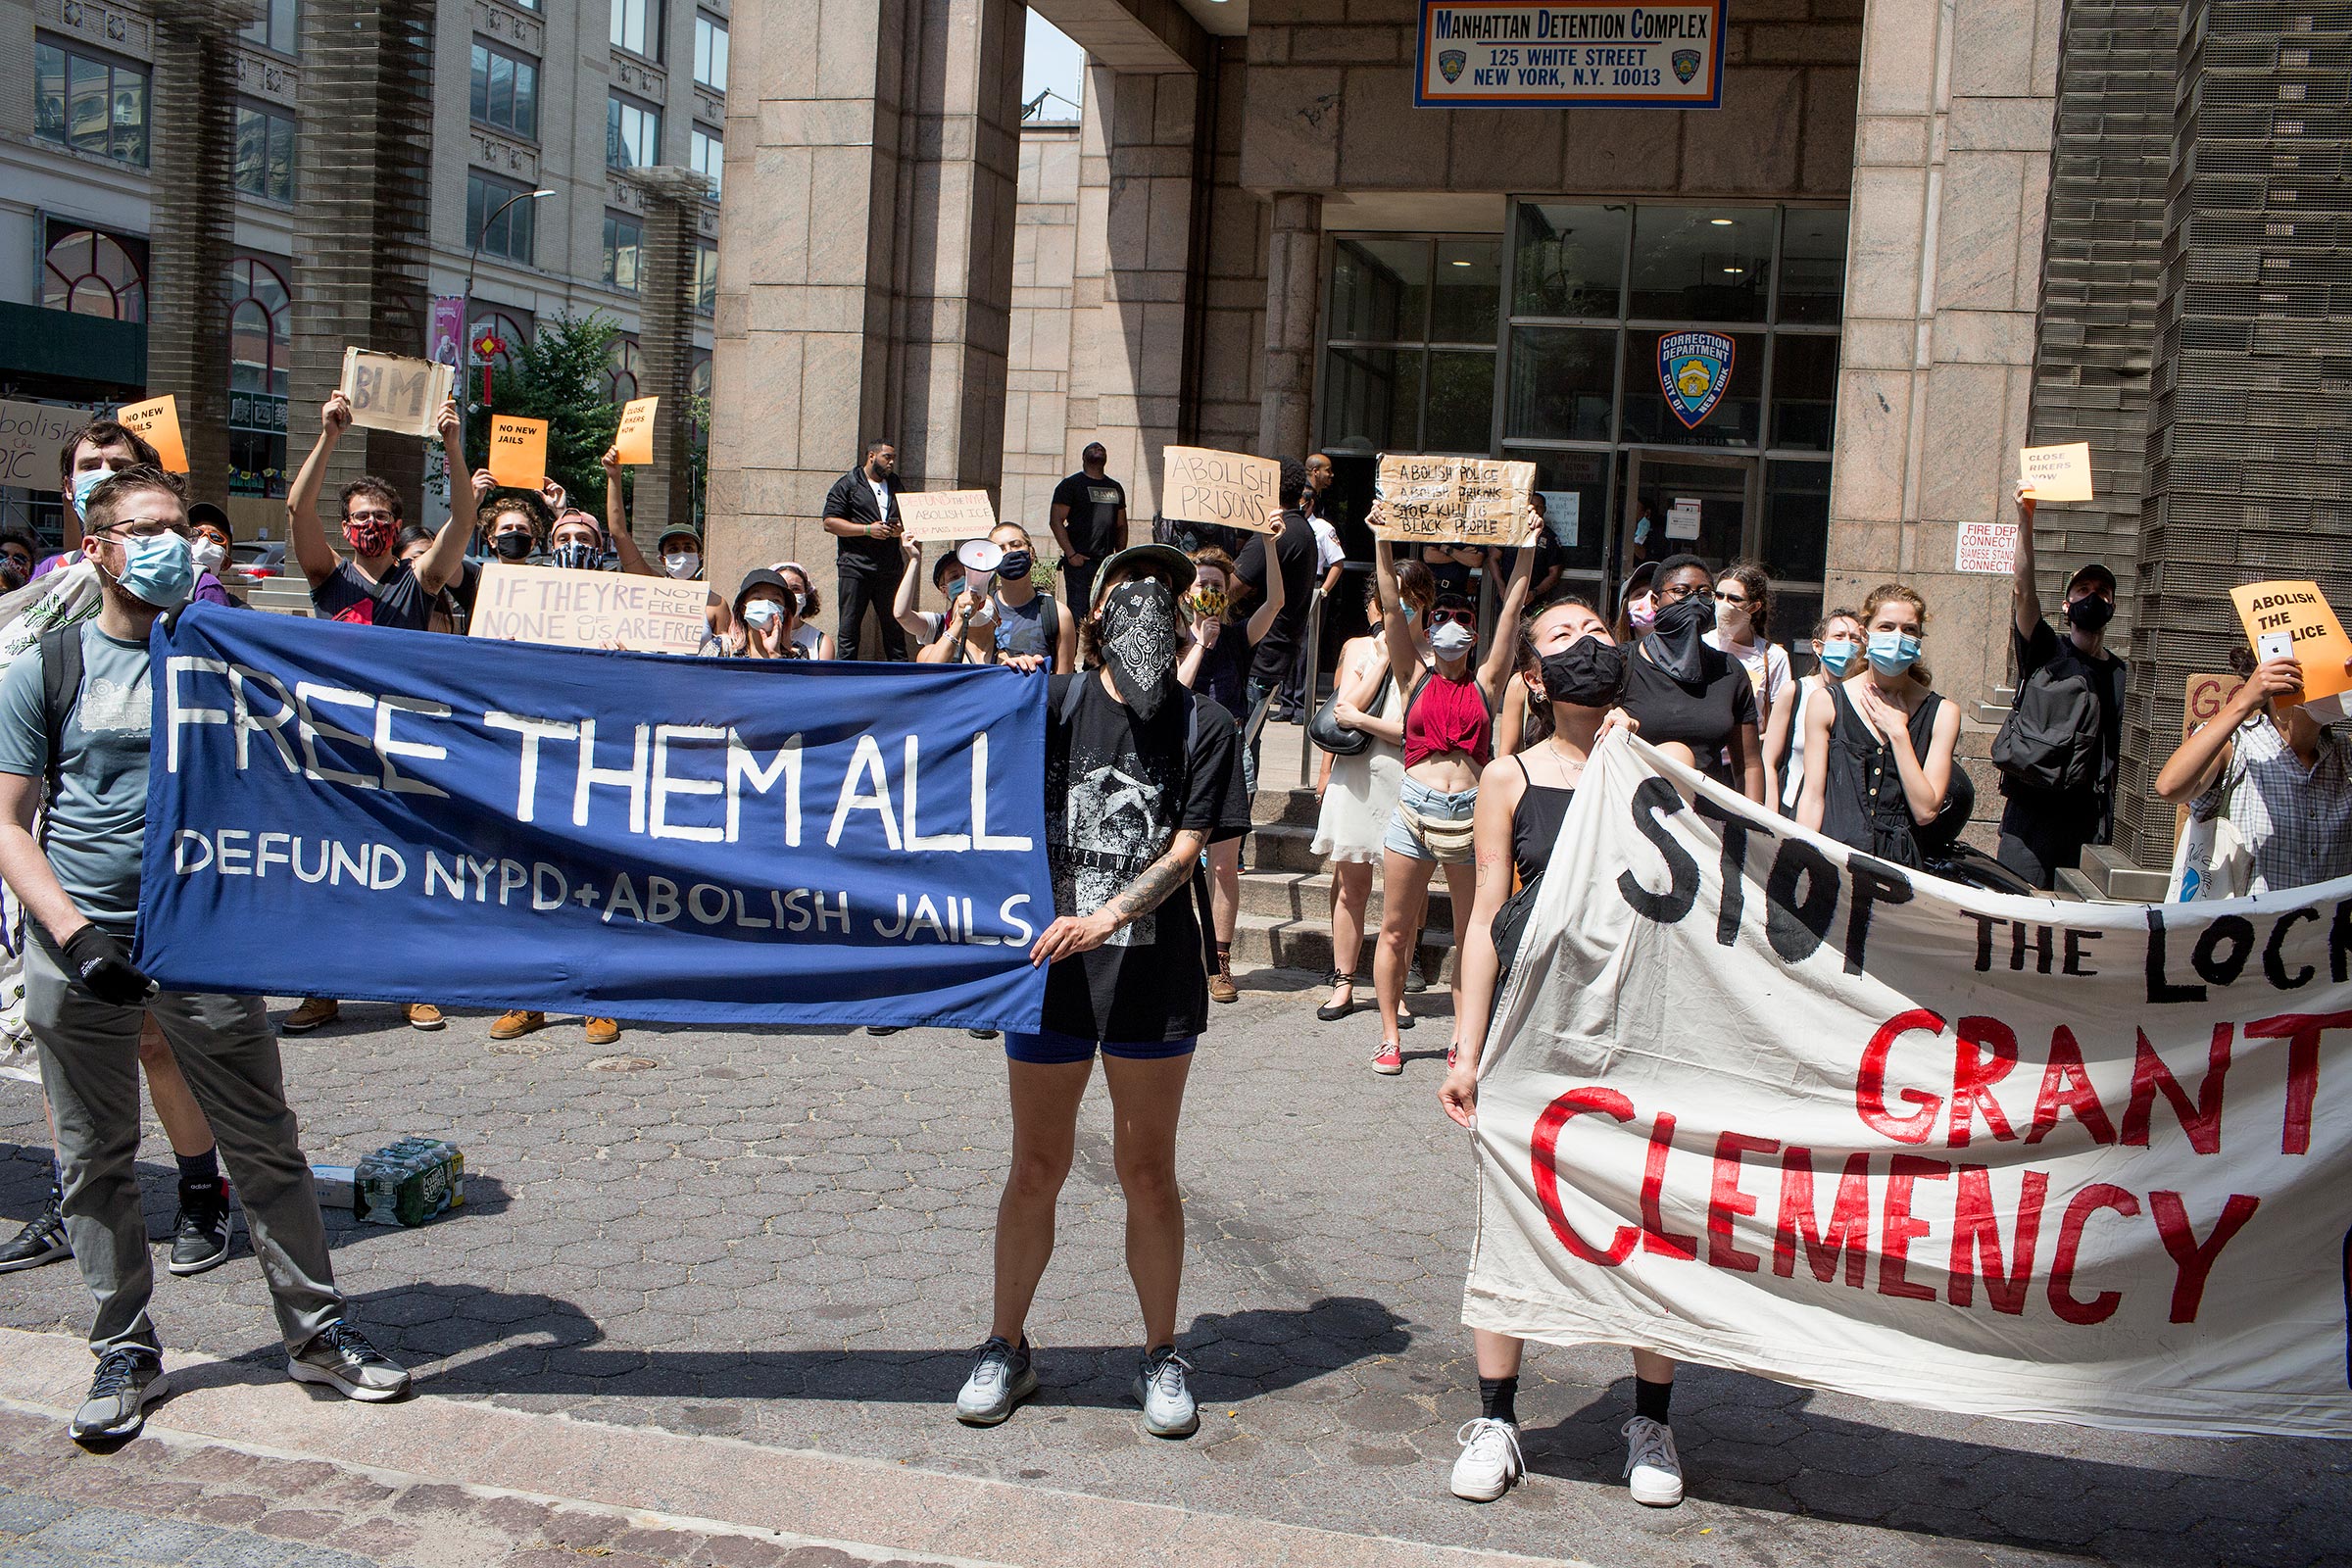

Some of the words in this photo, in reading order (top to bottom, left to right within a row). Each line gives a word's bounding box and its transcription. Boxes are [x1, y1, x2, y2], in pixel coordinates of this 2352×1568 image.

[1436, 10, 1530, 39] MANHATTAN
[1538, 9, 1625, 38] DETENTION
[1631, 8, 1707, 38] COMPLEX
[1490, 49, 1519, 66] 125
[1527, 49, 1578, 66] WHITE
[1585, 49, 1646, 66] STREET
[1474, 69, 1510, 85] NEW
[1518, 69, 1565, 88] YORK,
[1573, 69, 1604, 85] N.Y.
[1612, 69, 1661, 85] 10013
[1662, 333, 1730, 352] CORRECTION
[1662, 344, 1730, 362] DEPARTMENT
[353, 365, 428, 417] BLM
[1663, 373, 1677, 397] CITY
[1672, 398, 1685, 412] OF
[1697, 393, 1717, 414] NEW
[1713, 367, 1730, 393] YORK
[125, 413, 139, 423] NO
[141, 407, 164, 419] NEW
[626, 406, 646, 416] CLOSE
[126, 421, 153, 433] AILS
[623, 416, 646, 424] RIKERS
[515, 426, 537, 435] NEW
[620, 425, 636, 435] NOW
[498, 435, 524, 445] JAILS
[2029, 453, 2066, 462] CLOSE
[1399, 465, 1452, 480] ABOLISH
[1459, 466, 1498, 480] POLICE
[2030, 463, 2072, 471] RIKERS
[1172, 455, 1272, 497] ABOLISH
[900, 493, 952, 507] DEFUND
[1400, 486, 1450, 498] ABOLISH
[1458, 486, 1502, 502] PRISONS
[915, 510, 963, 520] ABOLISH
[967, 508, 992, 517] ICE
[1182, 486, 1265, 526] PRISONS
[1393, 503, 1430, 518] STOP
[1436, 503, 1487, 518] KILLING
[1402, 518, 1443, 532] BLACK
[1455, 519, 1498, 533] PEOPLE
[1967, 524, 1991, 535] FIRE
[1961, 535, 2017, 547] CONNECTI
[1960, 548, 1989, 560] SIAMESE
[495, 578, 528, 608] IF
[653, 587, 707, 601] NOT
[648, 600, 702, 614] FREE
[2252, 593, 2317, 612] ABOLISH
[482, 610, 565, 638] NONE
[577, 614, 609, 624] OF
[2258, 612, 2291, 630] THE
[577, 624, 612, 641] US
[615, 617, 660, 640] ARE
[662, 621, 704, 643] FREE
[2291, 624, 2328, 643] LICE
[167, 656, 452, 799] FREE
[484, 711, 802, 848] THEM
[826, 731, 1033, 853] ALL
[1617, 776, 1914, 980] STOP
[175, 829, 407, 891] DEFUND
[874, 893, 1032, 947] JAILS
[1959, 908, 2103, 976] THE
[1856, 1007, 2352, 1155] GRANT
[1531, 1087, 2261, 1325] CLEMENCY
